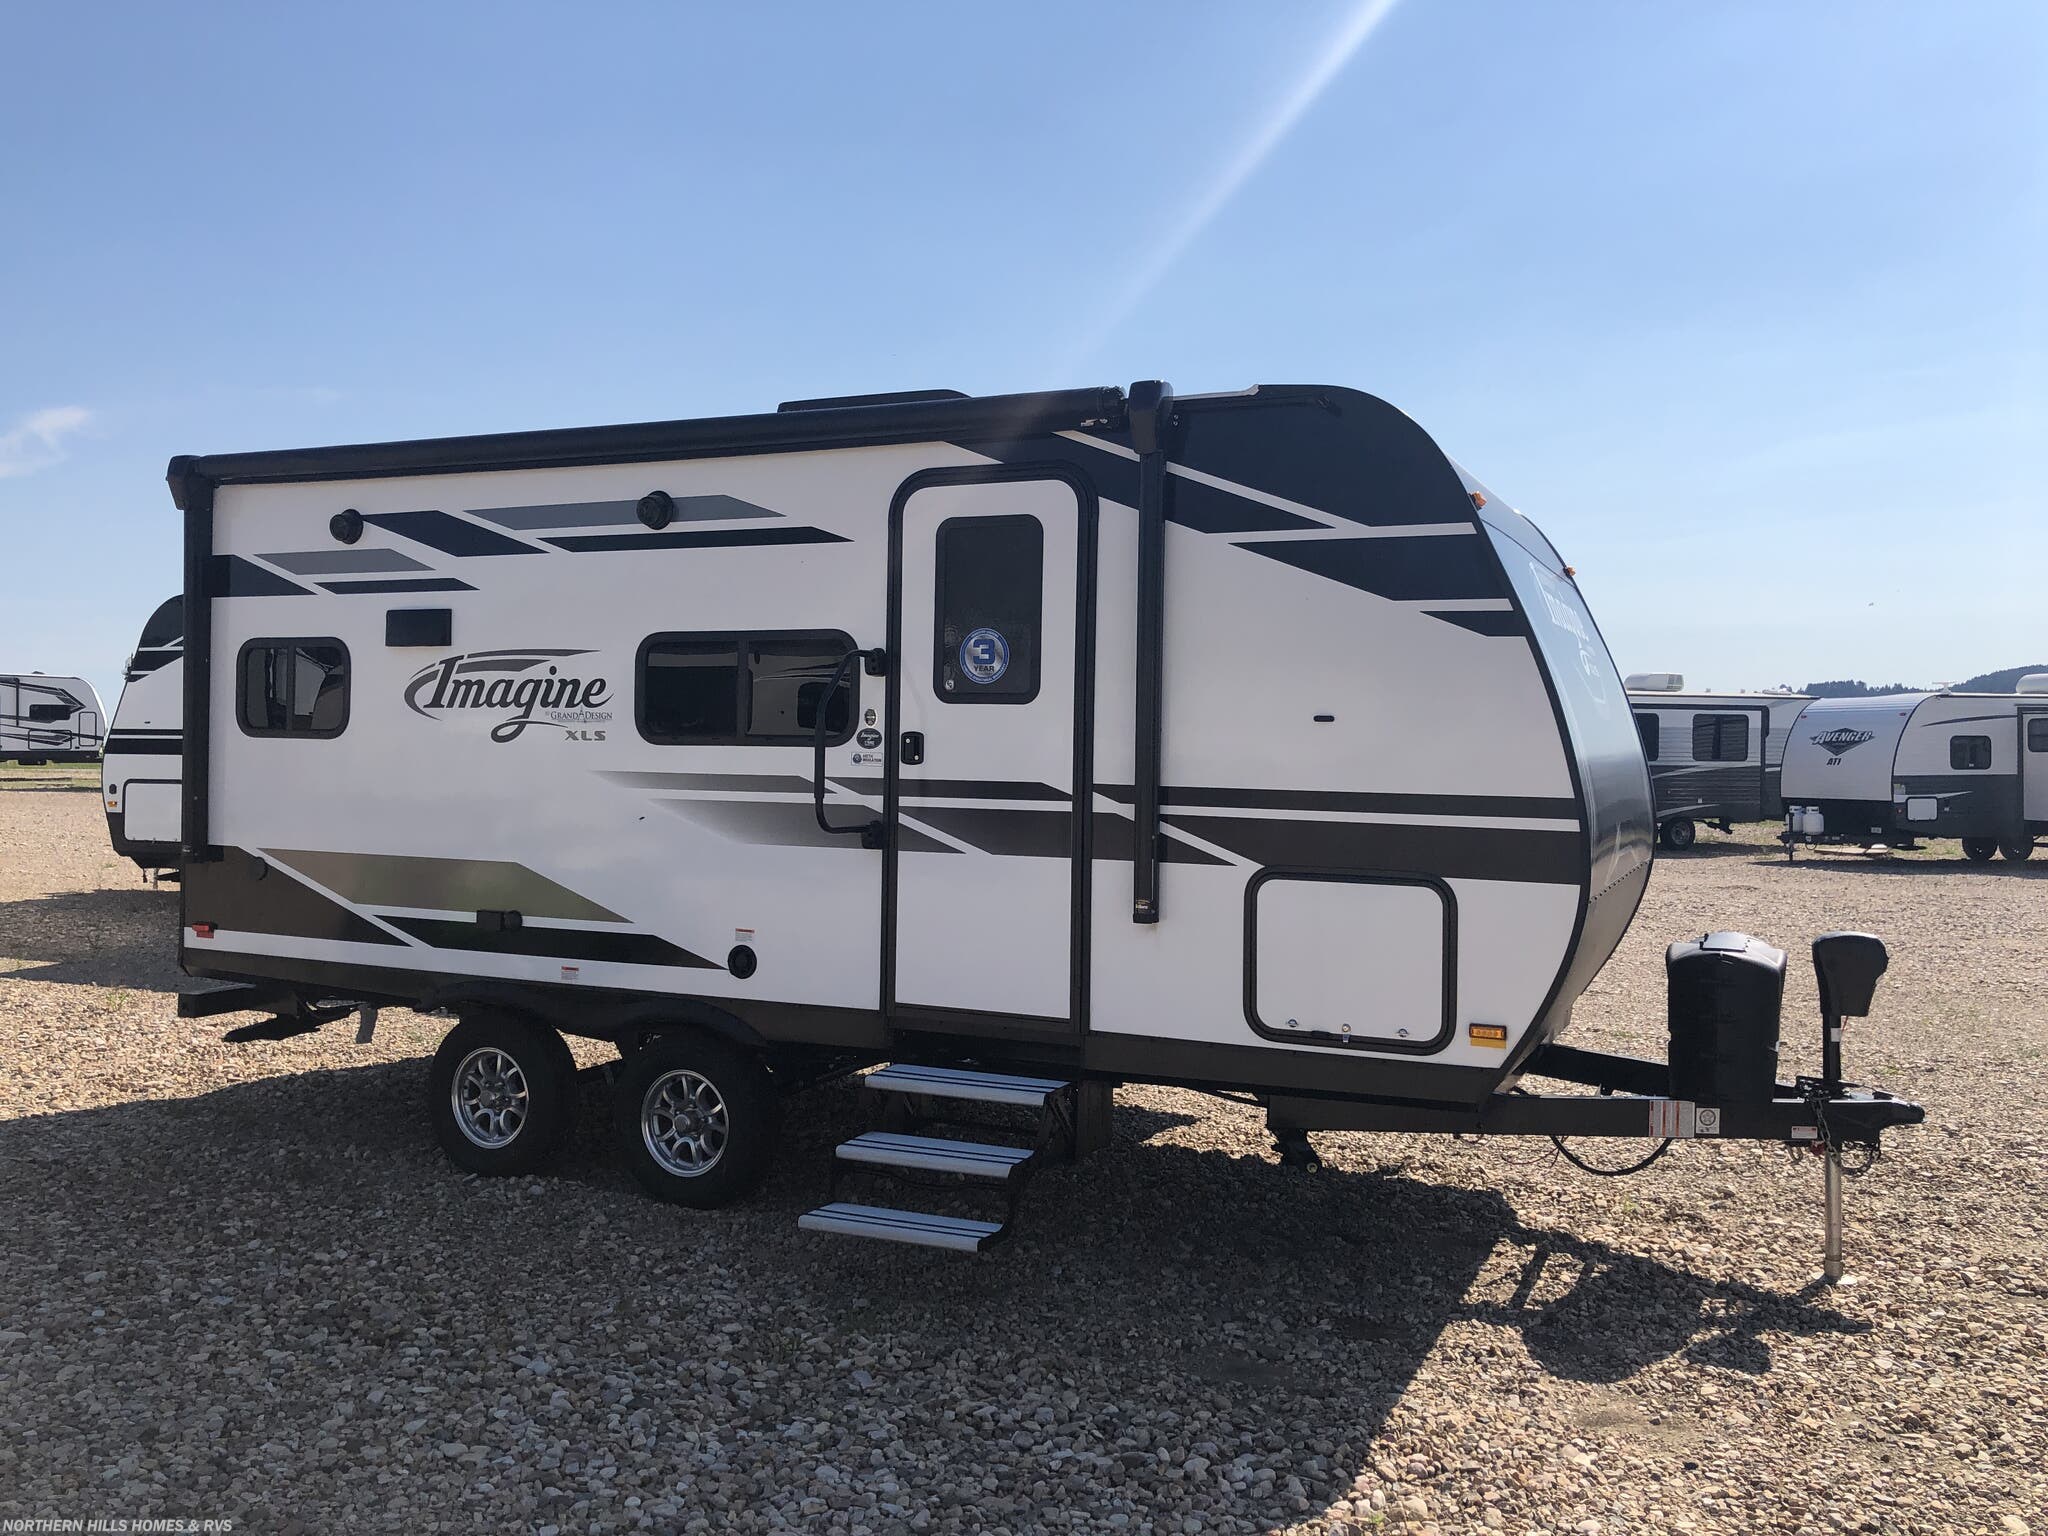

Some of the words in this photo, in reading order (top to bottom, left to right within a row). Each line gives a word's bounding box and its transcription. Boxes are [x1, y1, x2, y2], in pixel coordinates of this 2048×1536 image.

[973, 638, 995, 665] 3
[423, 655, 614, 743] Imagine
[550, 710, 578, 720] GRAND
[585, 710, 612, 720] DESIGN
[564, 730, 606, 741] XLS
[1812, 731, 1872, 744] AVENGER
